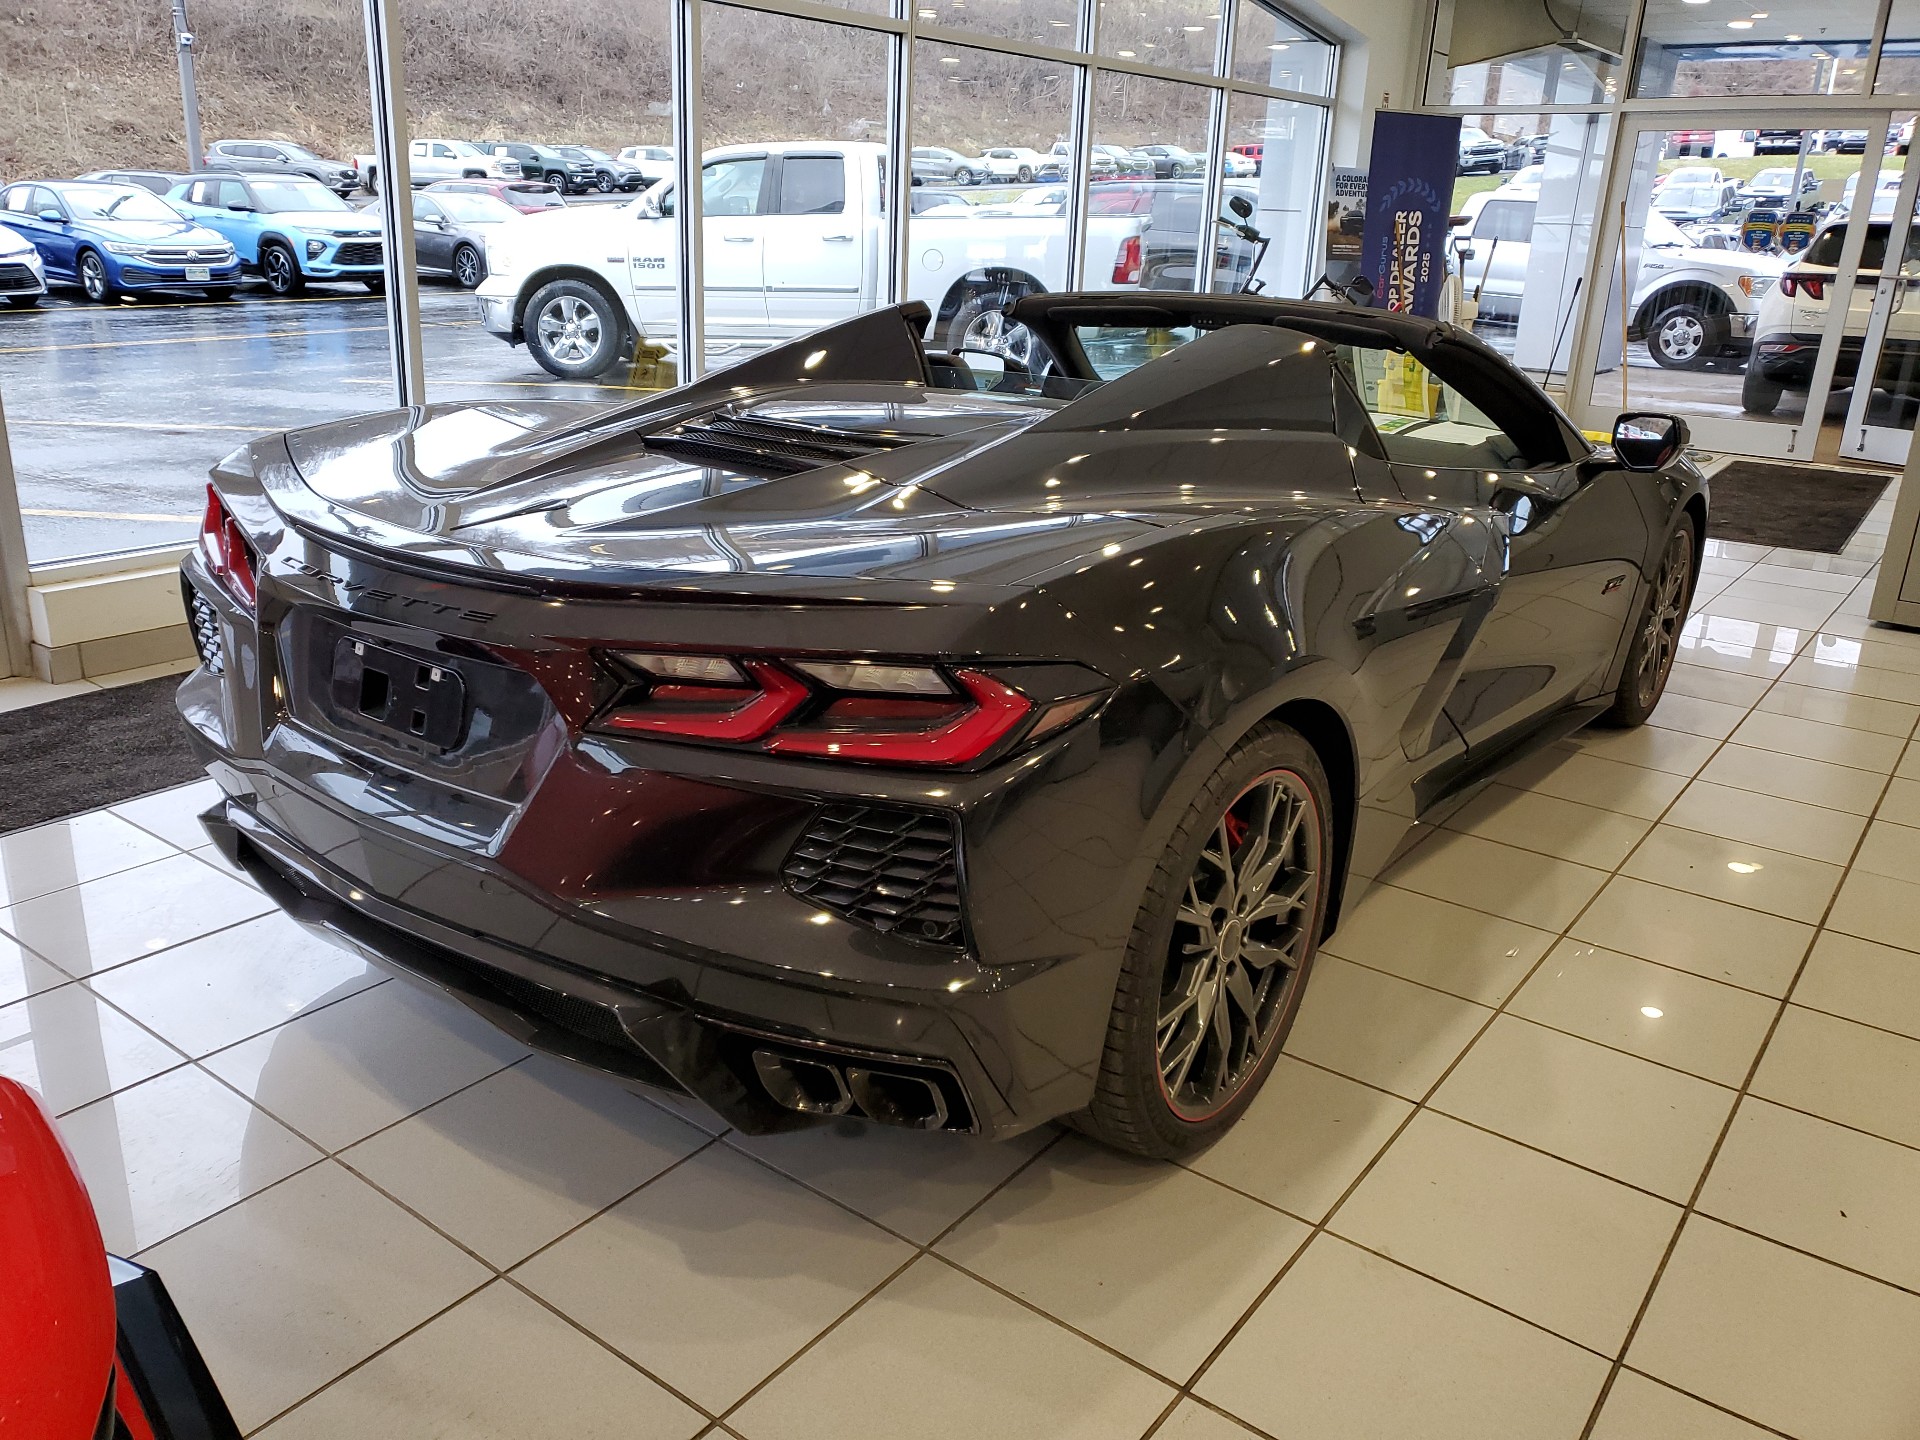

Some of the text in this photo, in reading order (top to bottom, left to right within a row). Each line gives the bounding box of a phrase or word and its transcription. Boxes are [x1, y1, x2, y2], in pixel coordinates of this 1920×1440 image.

[1342, 175, 1367, 183] COLORA
[1377, 236, 1389, 299] CarGurus
[1400, 210, 1422, 315] AWARDS
[1420, 252, 1431, 283] 2025
[281, 556, 498, 624] CORVETTE
